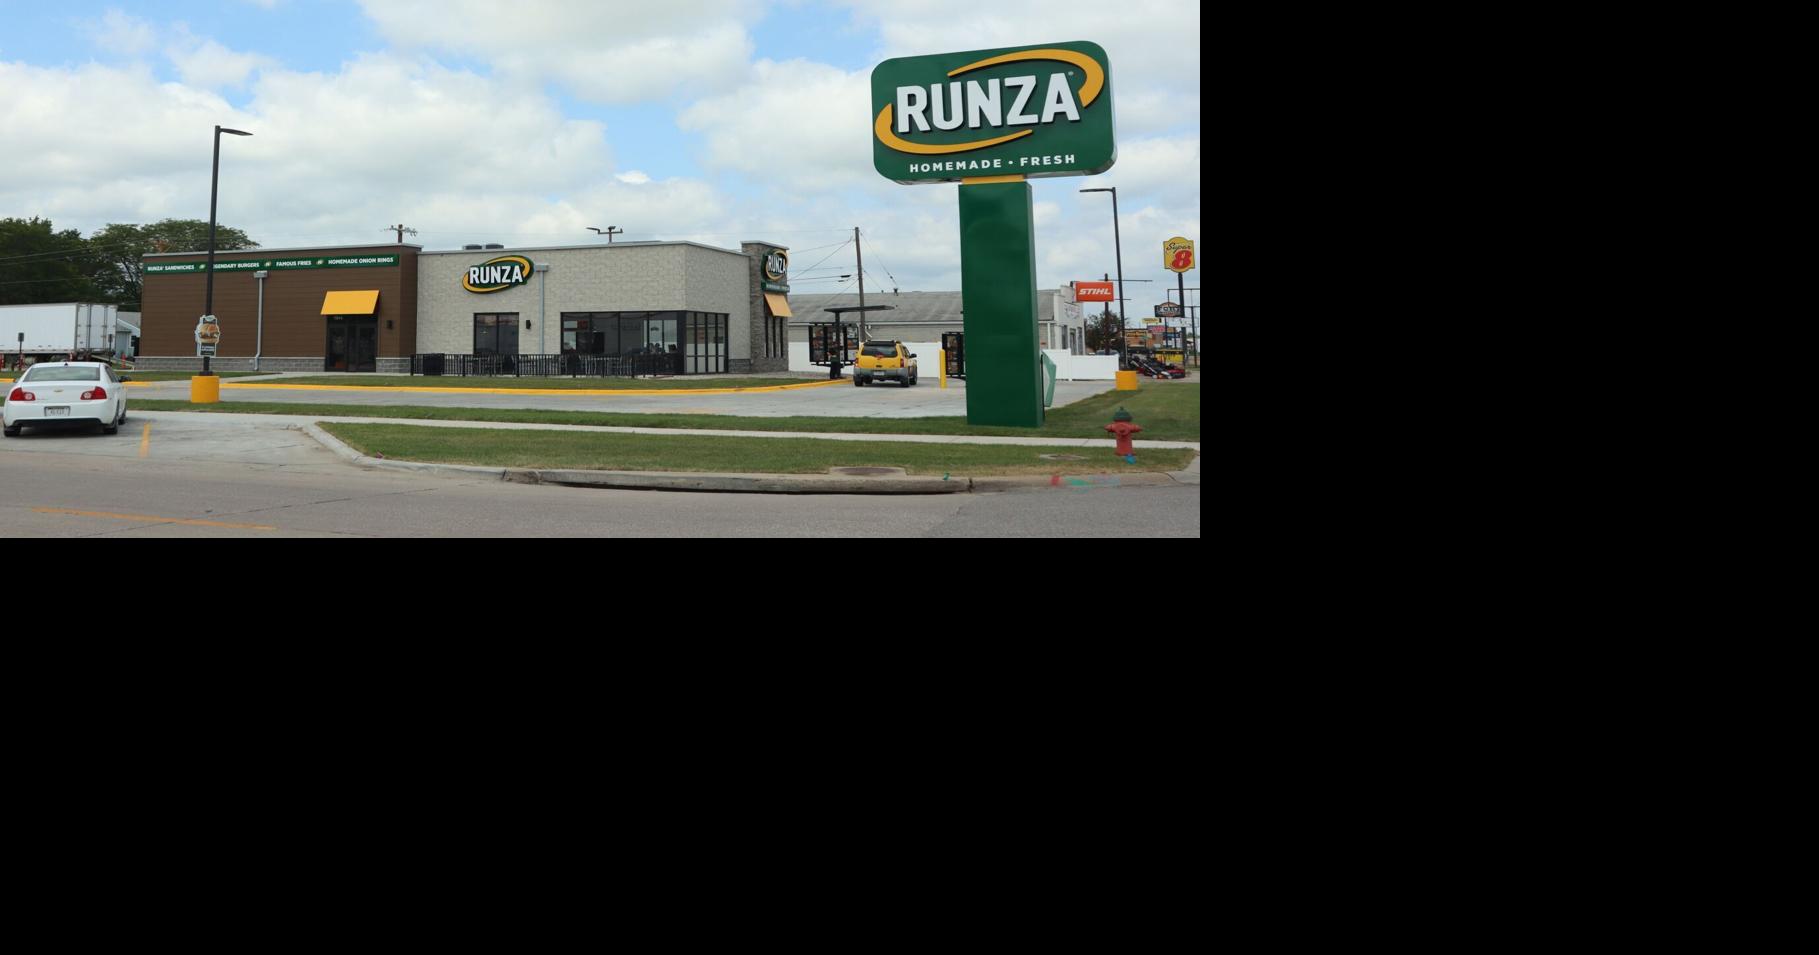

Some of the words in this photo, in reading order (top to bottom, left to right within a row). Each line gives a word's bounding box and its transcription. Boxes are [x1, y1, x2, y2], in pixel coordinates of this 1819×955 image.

[896, 72, 1080, 133] RUNZA
[909, 158, 1002, 173] HOMEMADE
[1020, 154, 1075, 167] FRESH
[1171, 250, 1192, 269] 8
[469, 265, 523, 284] RUNZA
